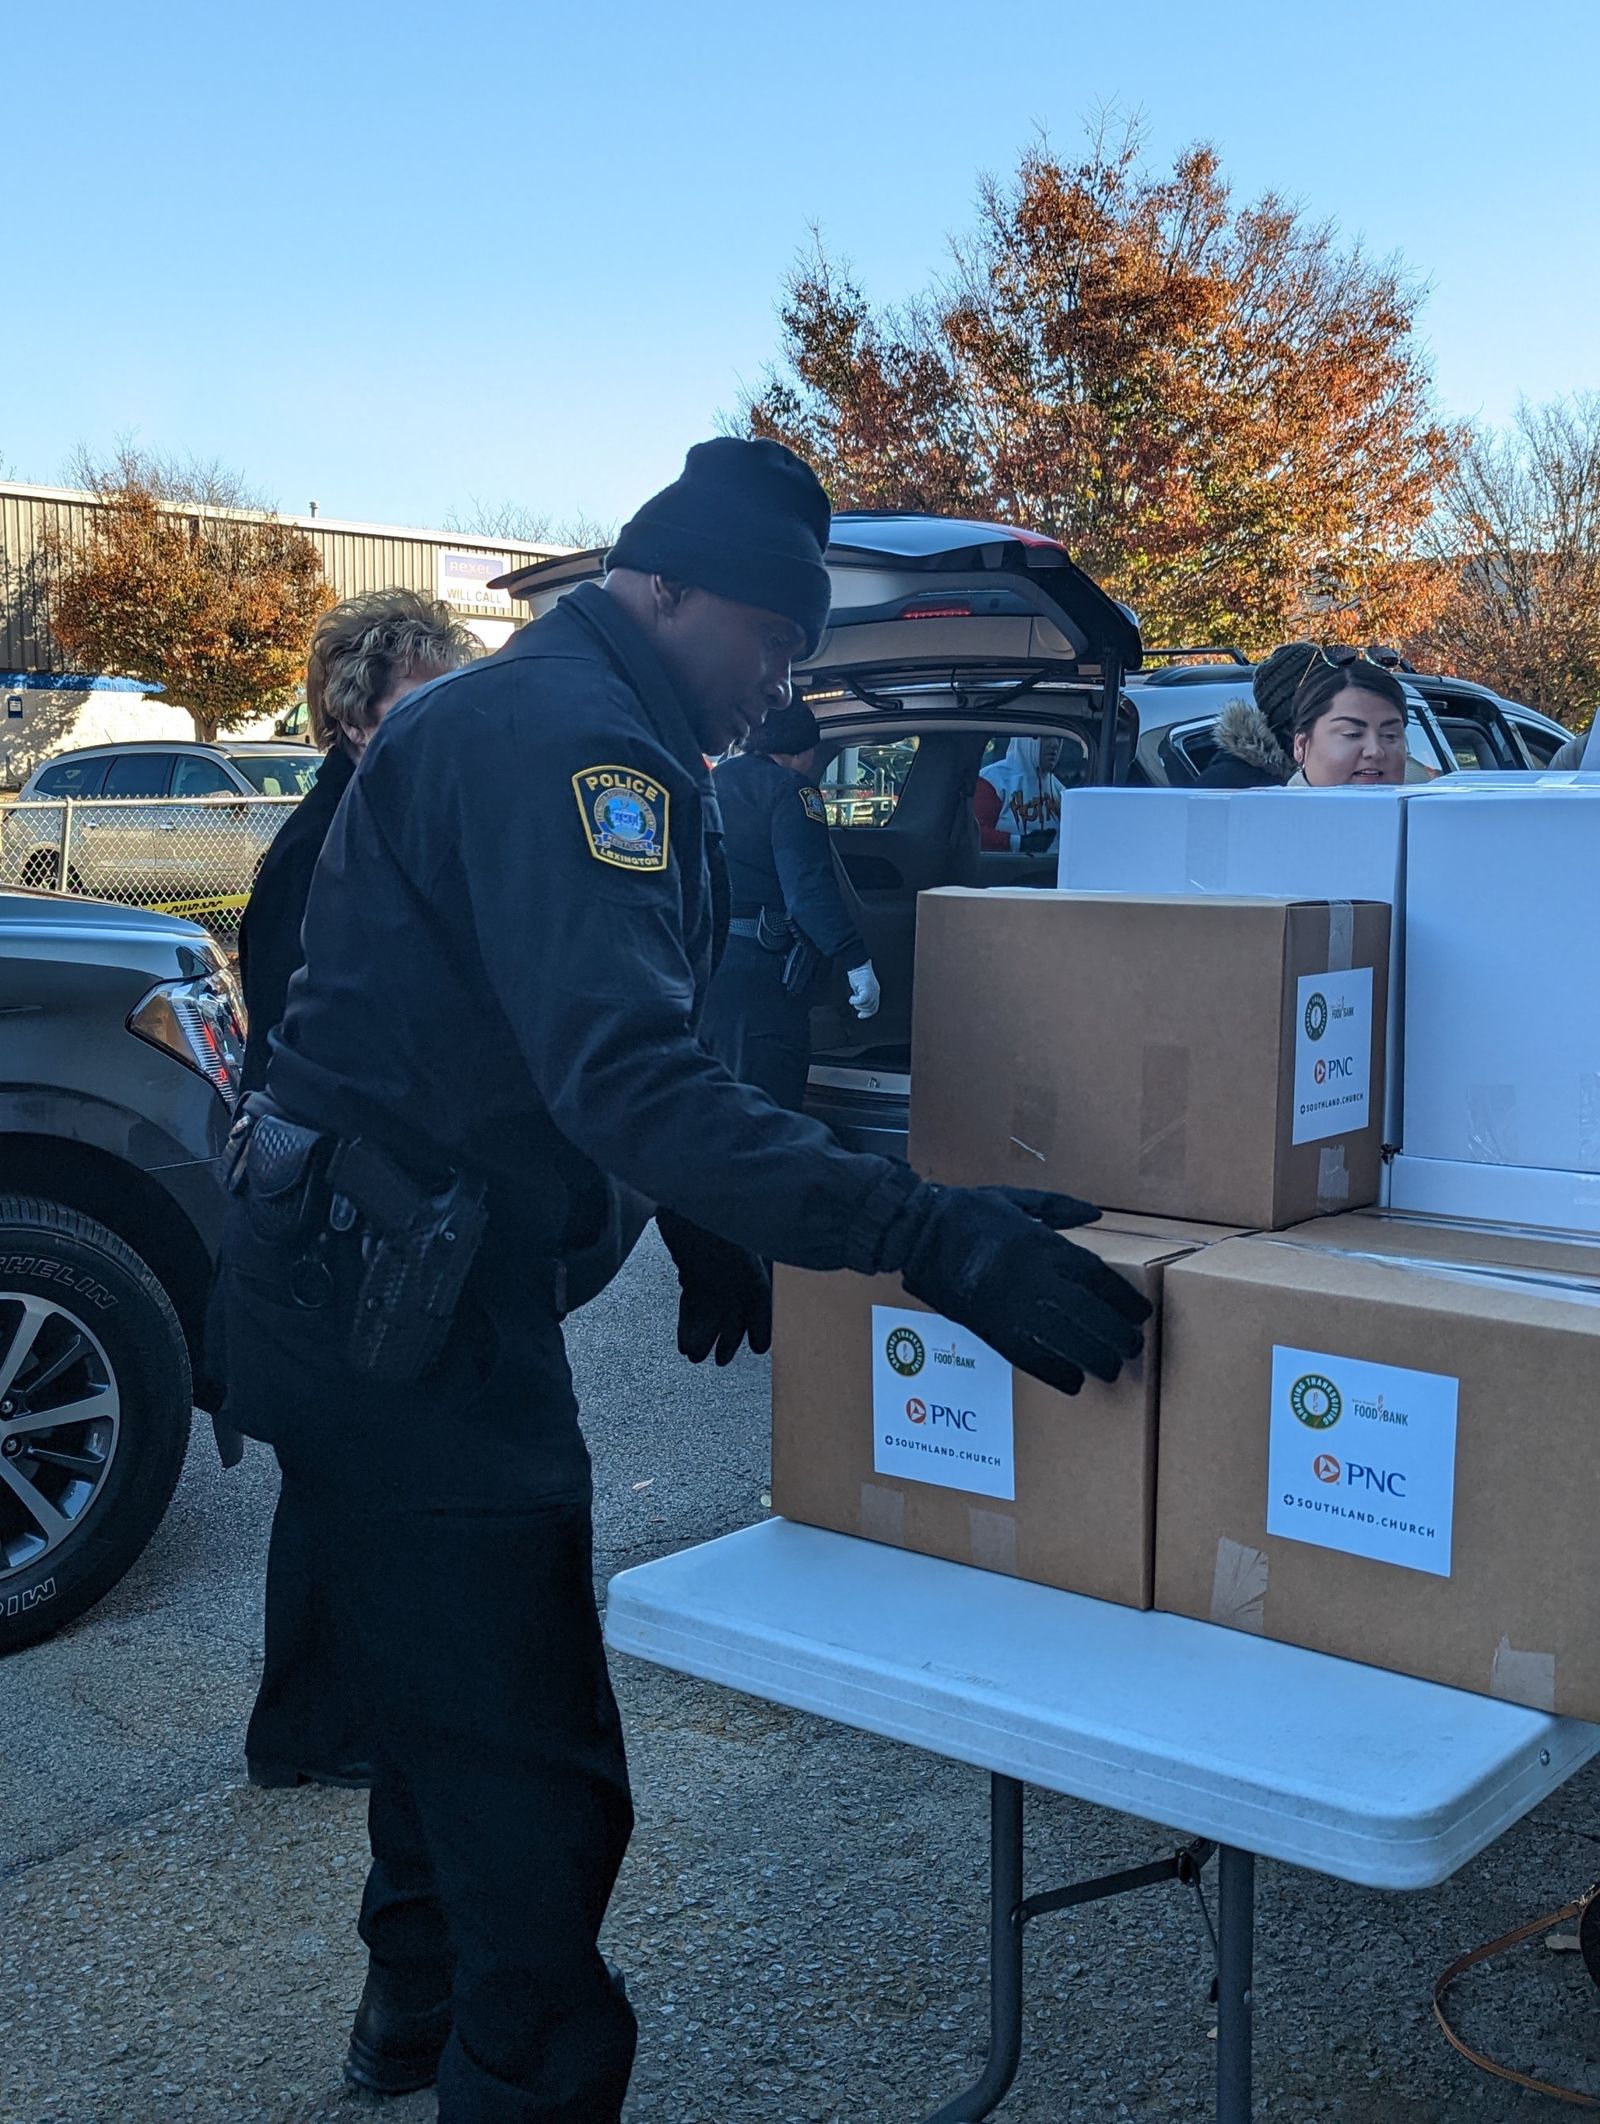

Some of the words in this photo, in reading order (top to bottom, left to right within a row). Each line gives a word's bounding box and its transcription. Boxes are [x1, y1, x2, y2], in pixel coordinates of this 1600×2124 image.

[447, 588, 471, 601] WILL
[475, 591, 502, 604] CALL
[585, 773, 658, 802] POLICE
[600, 847, 659, 865] LEXINGTON
[1328, 1056, 1353, 1080] PNC
[1306, 1093, 1364, 1113] SOUTHLAND.CHURCH
[0, 1256, 119, 1310] HELIN
[934, 1352, 952, 1365] FOOD
[956, 1356, 976, 1369] BANK
[1305, 1377, 1339, 1425] THANKSGIVING
[930, 1404, 977, 1432] PNC
[1354, 1404, 1378, 1420] FOOD
[1383, 1410, 1409, 1427] BANK
[895, 1438, 1001, 1466] SOUTHLAND.CHURCH
[1345, 1462, 1407, 1498] PNC
[1297, 1498, 1435, 1538] SOUTHLAND.CHURCH
